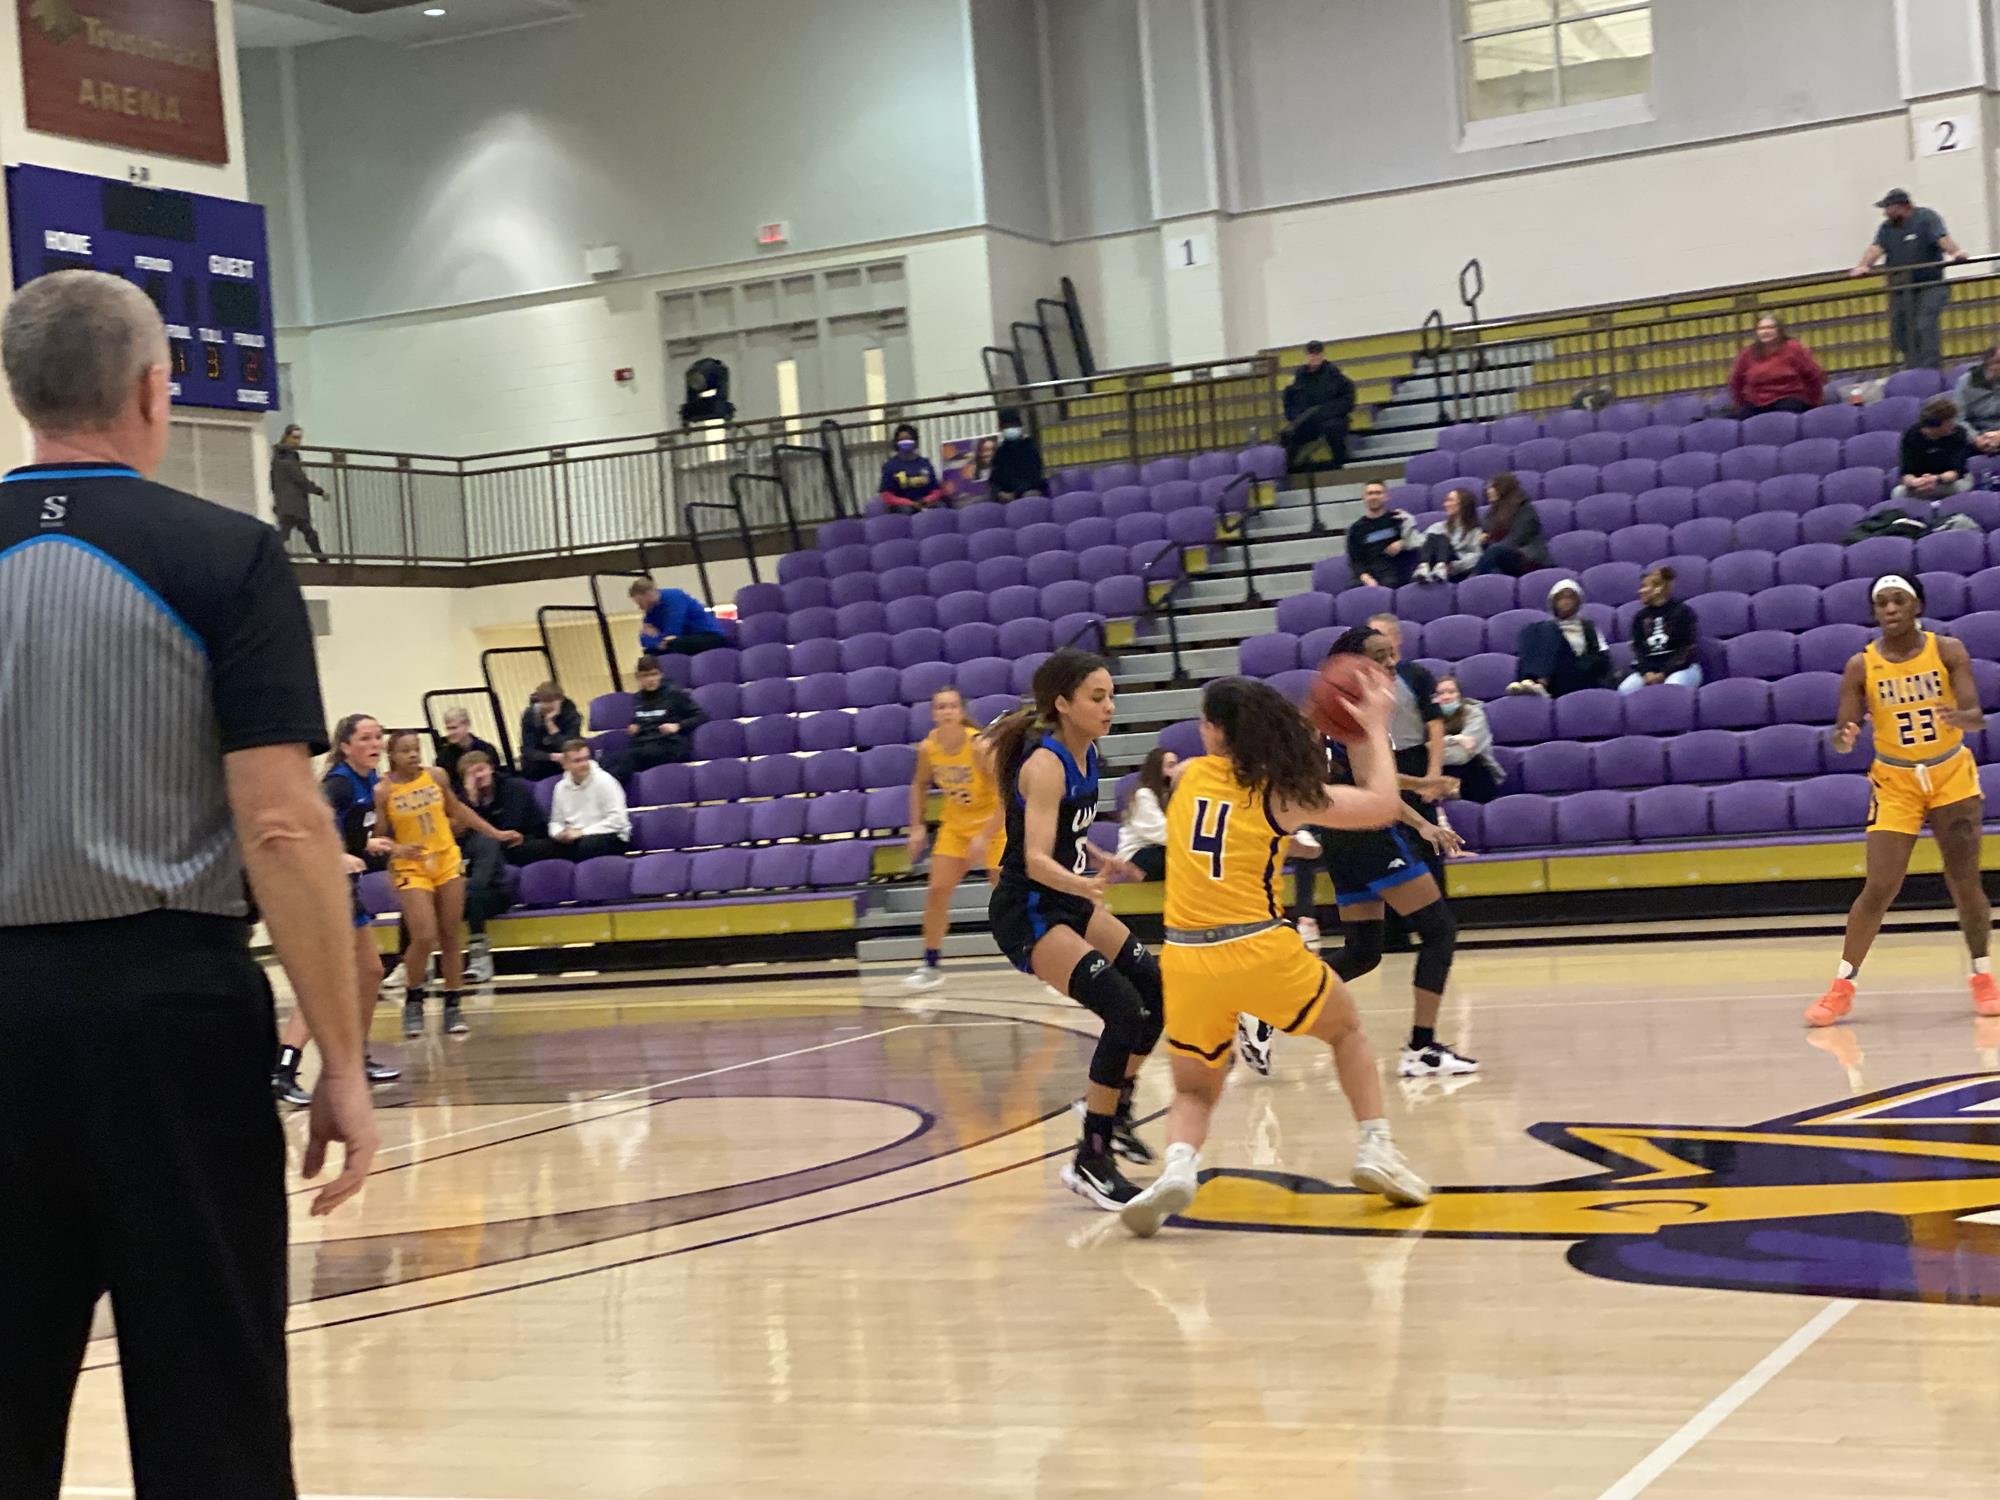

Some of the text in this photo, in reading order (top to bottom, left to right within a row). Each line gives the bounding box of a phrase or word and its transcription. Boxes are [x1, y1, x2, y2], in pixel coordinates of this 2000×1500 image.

[1934, 120, 1959, 152] 2
[1180, 238, 1197, 266] 1
[1877, 670, 1943, 705] FALCONS
[1894, 707, 1938, 747] 23
[1189, 796, 1232, 881] 4
